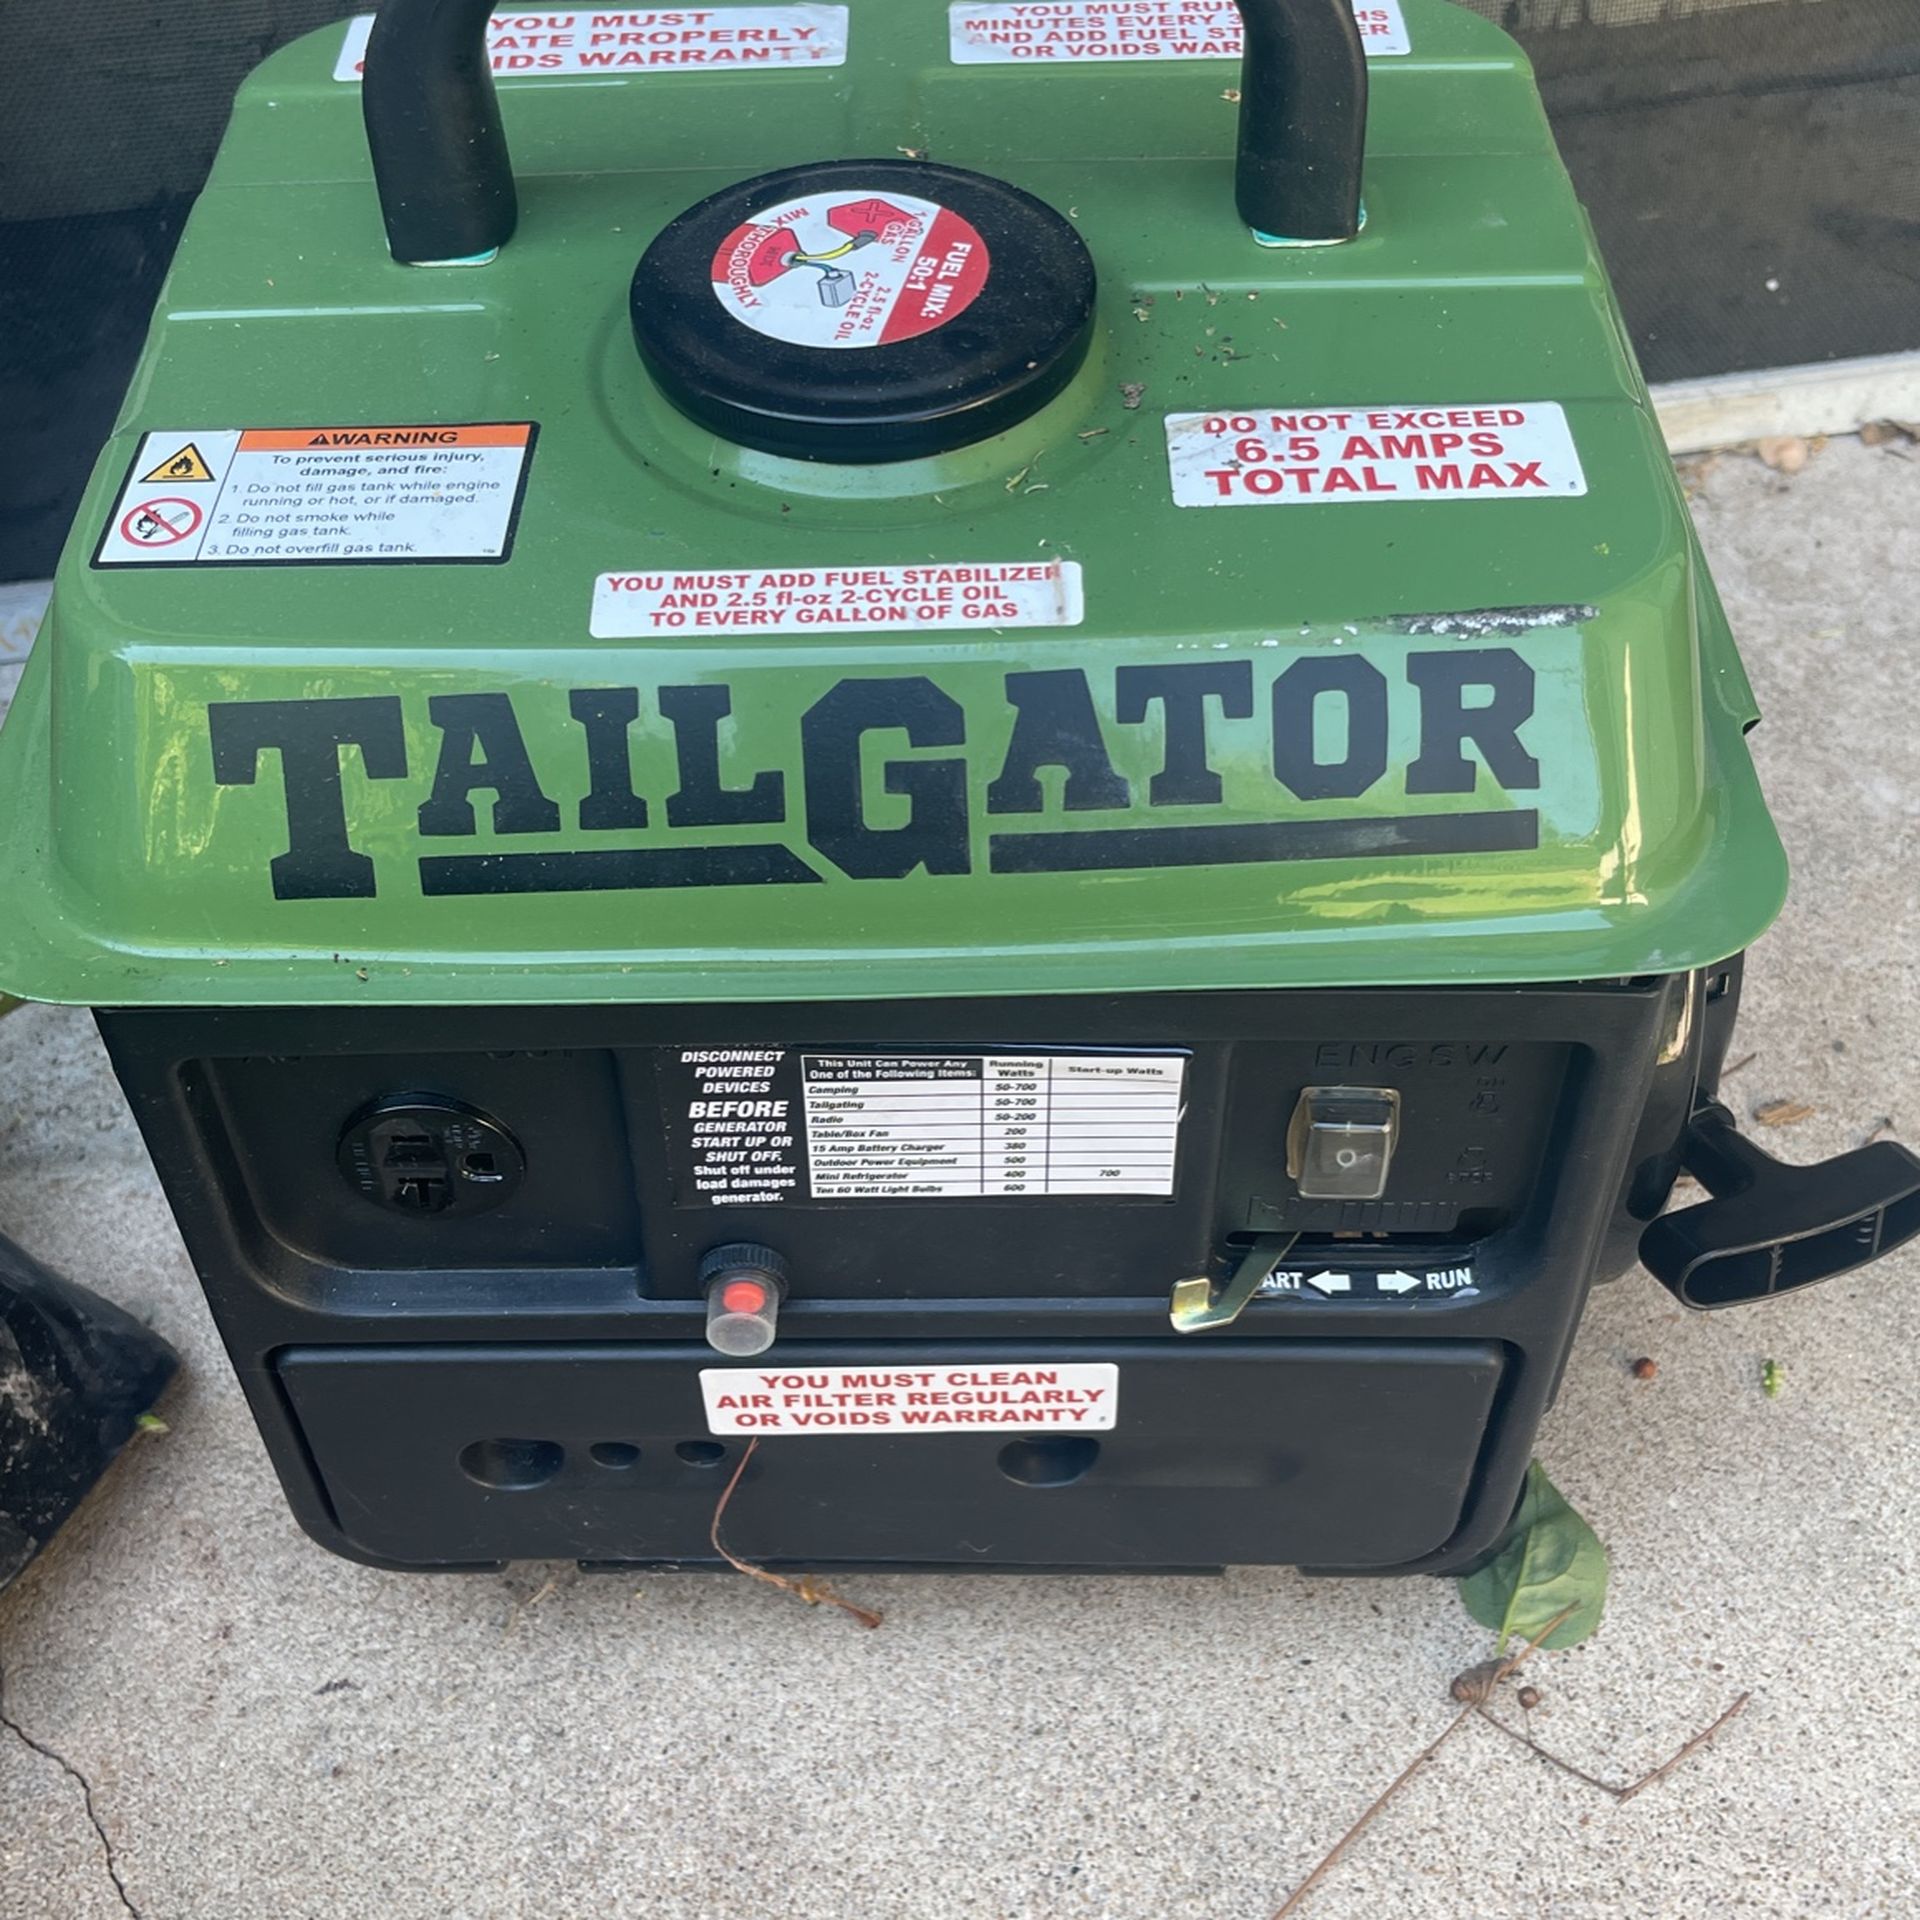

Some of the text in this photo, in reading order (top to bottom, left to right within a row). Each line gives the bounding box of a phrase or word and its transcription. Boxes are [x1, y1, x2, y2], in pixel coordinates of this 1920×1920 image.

[1010, 5, 1074, 17] YOU
[1085, 2, 1171, 16] MUST
[491, 13, 714, 31] YOU MUST
[965, 17, 1106, 31] MINUTES
[1117, 15, 1216, 28] EVERY
[590, 27, 818, 47] PROPERLY
[1044, 30, 1108, 43] ADD
[1119, 28, 1197, 42] FUEL
[1010, 45, 1055, 58] OR
[1064, 43, 1162, 57] VOIDS
[493, 47, 828, 70] IDS WARRANTY
[881, 222, 902, 245] GAS
[729, 207, 810, 308] MIX THOROUGHLY
[906, 256, 938, 290] 50:1
[920, 242, 972, 318] FUEL MIX:
[834, 271, 879, 340] 2-CYCLE OIL
[1203, 410, 1525, 434] DO NOT EXCEED
[331, 432, 458, 445] WARNING
[1234, 432, 1504, 465] 6.5 AMPS
[272, 452, 485, 466] To prevent serious injury,
[299, 465, 448, 477] damage, and fire:
[1205, 462, 1550, 496] TOTAL MAX
[247, 483, 271, 493] Do
[275, 483, 301, 493] not
[305, 483, 323, 492] fill
[326, 484, 356, 495] gas
[361, 481, 396, 491] tank
[400, 480, 441, 490] while
[446, 480, 501, 492] engine
[242, 493, 479, 507] running or hot, or if damaged.
[236, 513, 260, 524] Do
[264, 513, 291, 523] not
[295, 512, 349, 523] smoke
[354, 511, 395, 521] while
[232, 526, 352, 539] filling gas tank.
[226, 544, 250, 555] Do
[255, 544, 284, 554] not
[285, 543, 340, 554] overfill
[343, 543, 374, 555] gas
[378, 542, 418, 553] tank.
[608, 577, 664, 592] YOU
[673, 575, 751, 590] MUST
[759, 573, 816, 588] ADD
[825, 571, 894, 586] FUEL
[660, 586, 1008, 608] AND 2.5 fl-oz 2-CYCLE OIL
[650, 603, 1018, 627] TO EVERY GALLON OF GAS
[681, 1050, 785, 1062] DISCONNECT
[818, 1059, 843, 1067] This
[847, 1059, 871, 1067] Unit
[943, 1060, 968, 1068] Any
[989, 1060, 1044, 1070] Running
[695, 1066, 775, 1078] POWERED
[810, 1070, 833, 1079] One
[837, 1069, 849, 1078] of
[853, 1069, 872, 1078] the
[875, 1069, 935, 1079] Following
[997, 1069, 1035, 1077] Watts
[1068, 1065, 1164, 1076] Start-up Watts
[702, 1081, 771, 1094] DEVICES
[808, 1086, 859, 1095] Camping
[995, 1083, 1037, 1091] 50-700
[809, 1100, 864, 1110] Tailgating
[994, 1097, 1037, 1106] 50-700
[688, 1100, 789, 1118] BEFORE
[811, 1116, 843, 1124] Radio
[994, 1112, 1036, 1121] 50-200
[693, 1121, 787, 1133] GENERATOR
[812, 1129, 889, 1138] Table/Box Fan
[1004, 1127, 1027, 1135] 200
[691, 1135, 793, 1148] START UP OR
[813, 1143, 945, 1153] 15 Amp Battery Charger
[705, 1150, 782, 1162] SHUT OFF.
[814, 1157, 957, 1168] Outdoor Power Equipment
[693, 1164, 796, 1175] Shut off under
[696, 1177, 796, 1189] load damages
[815, 1172, 908, 1182] Mini Refrigerator
[854, 1186, 879, 1194] Watt
[882, 1186, 909, 1194] Light
[912, 1185, 943, 1194] Bulbs
[711, 1191, 784, 1205] generator.
[1262, 1272, 1304, 1289] ART
[1426, 1267, 1473, 1290] RUN
[760, 1371, 1058, 1389] YOU MUST CLEAN
[716, 1389, 1105, 1408] AIR FILTER REGULARLY
[735, 1413, 782, 1427] OR
[790, 1411, 892, 1426] VOIDS
[900, 1408, 1089, 1424] WARRANTY
